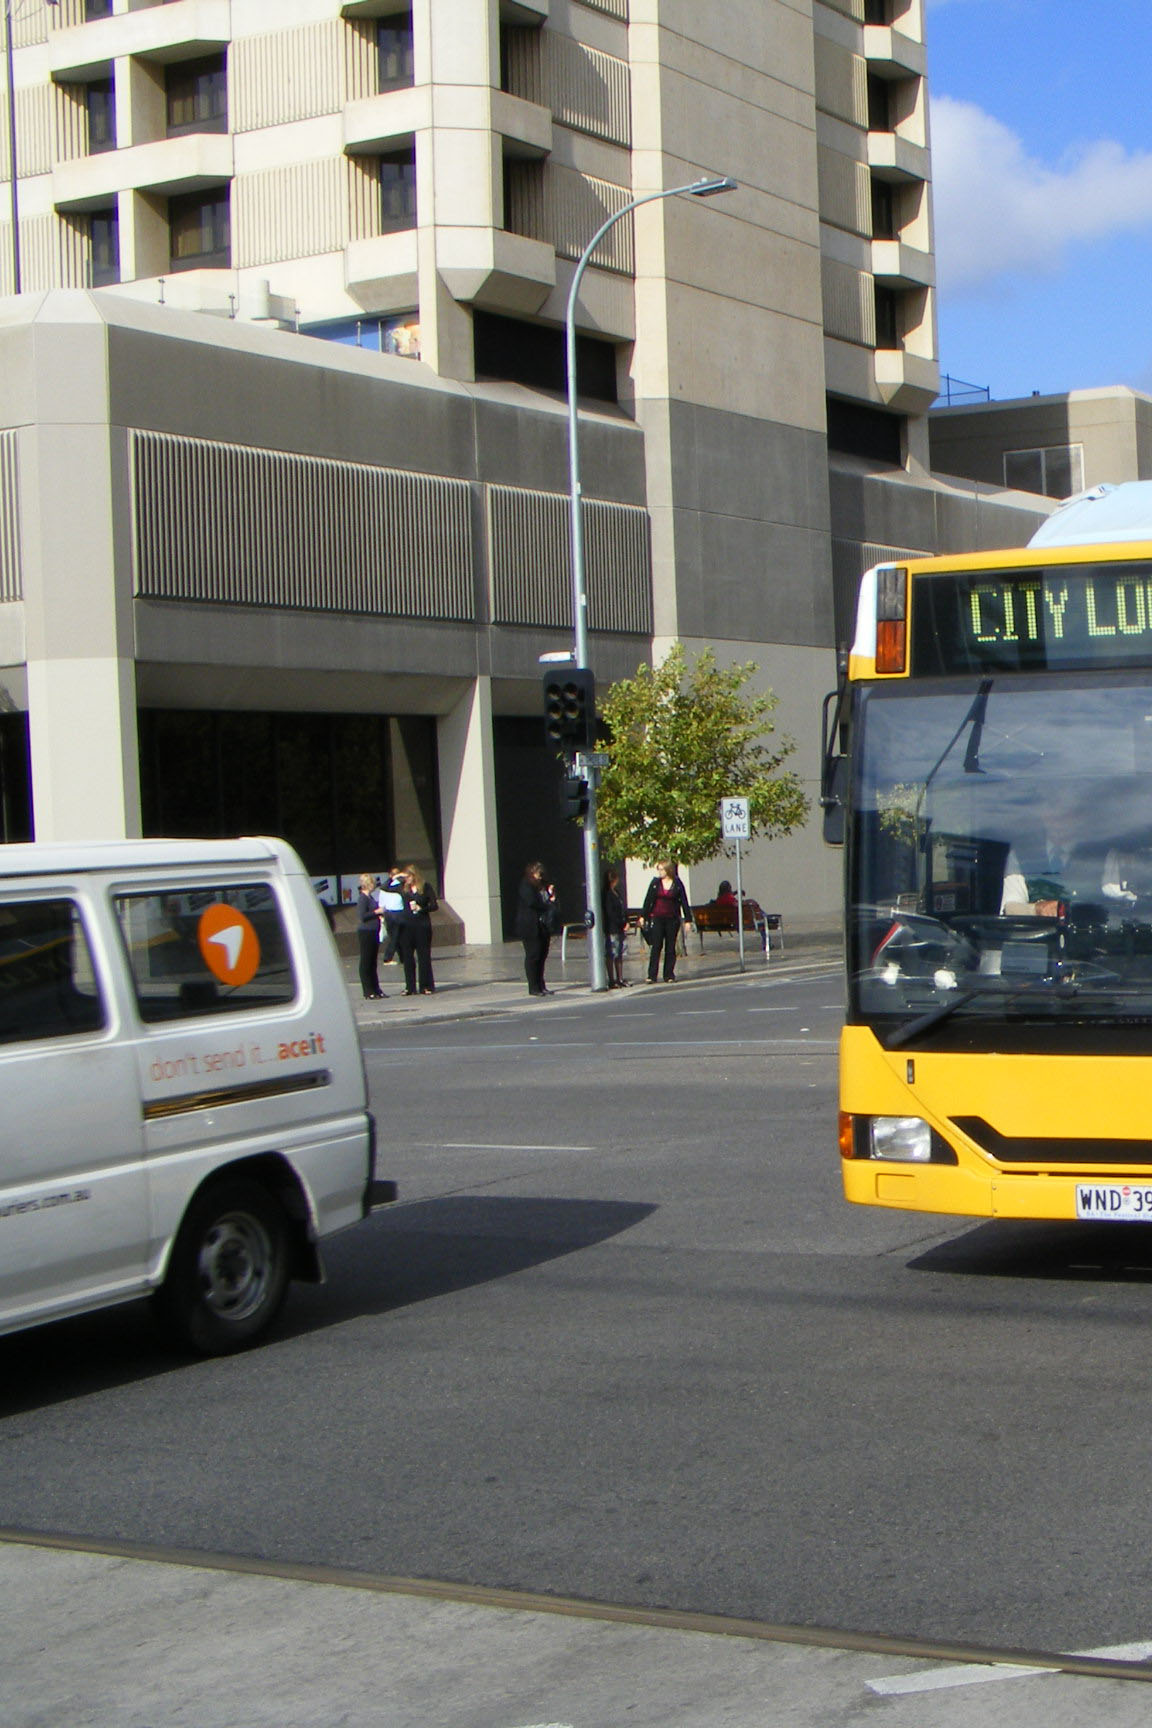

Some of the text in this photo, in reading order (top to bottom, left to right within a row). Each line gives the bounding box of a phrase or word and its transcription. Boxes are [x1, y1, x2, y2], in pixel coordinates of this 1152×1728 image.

[970, 579, 1068, 641] CITY
[724, 823, 747, 834] LANE
[150, 1054, 201, 1082] don't
[203, 1043, 245, 1073] send
[278, 1032, 326, 1061] aceit
[1080, 1189, 1122, 1211] WND
